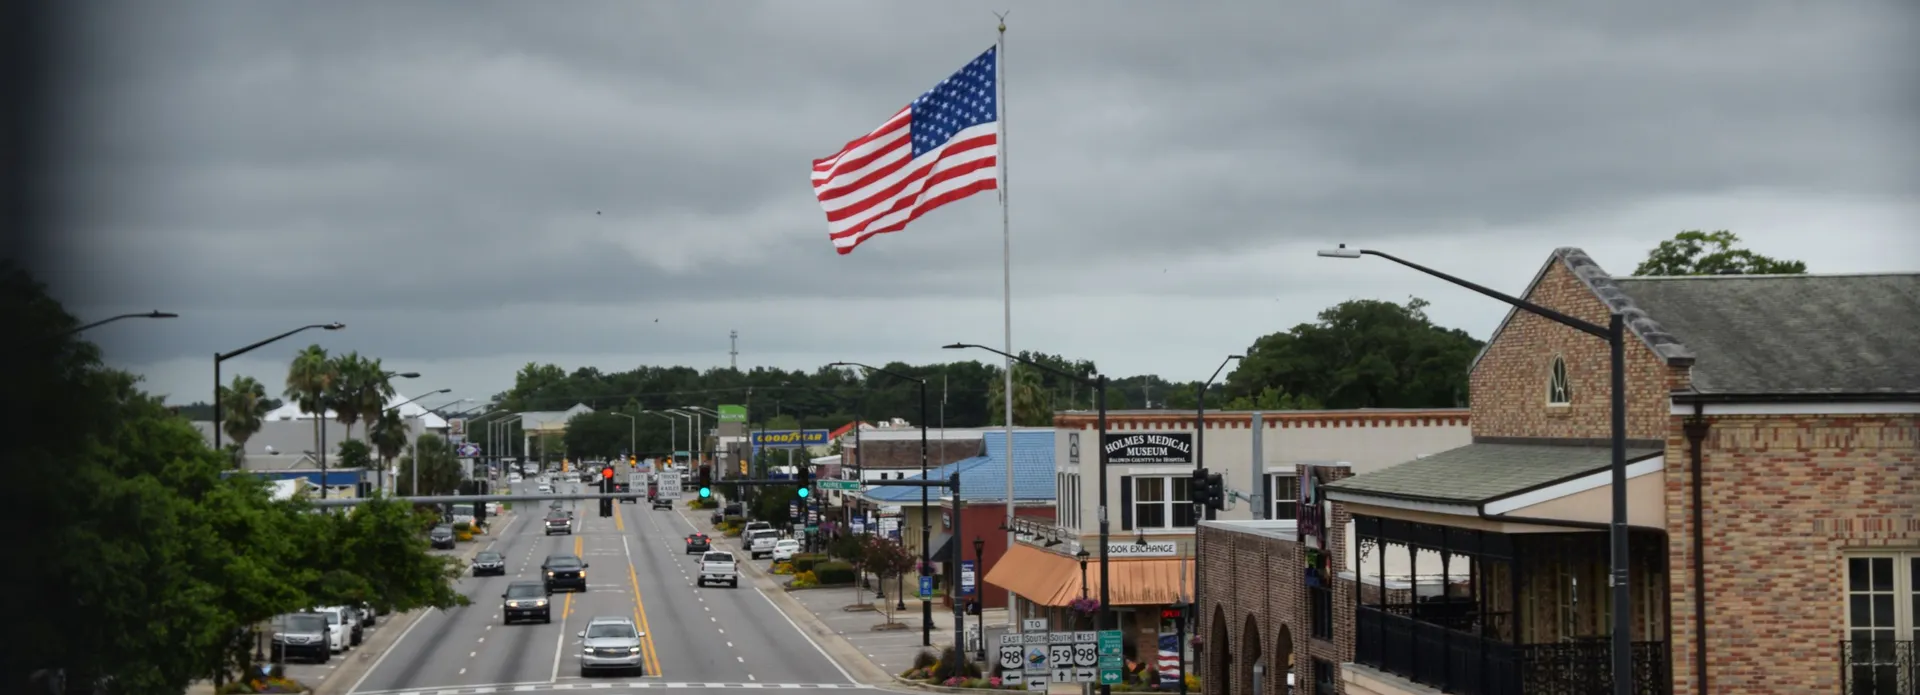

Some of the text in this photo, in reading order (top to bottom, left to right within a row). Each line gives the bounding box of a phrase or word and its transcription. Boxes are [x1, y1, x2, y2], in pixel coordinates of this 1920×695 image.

[757, 432, 822, 442] GOODYEAR
[1105, 435, 1190, 454] HOLMES MEDICAL
[1126, 447, 1168, 456] MUSEUM
[1130, 544, 1174, 553] EXCHANGE
[1002, 636, 1020, 644] EAST
[1025, 635, 1047, 643] SOUTH
[1050, 633, 1072, 641] SOUTH
[1076, 633, 1095, 641] WEST
[1003, 651, 1020, 664] 98
[1052, 650, 1071, 663] 59
[1077, 648, 1095, 661] 98
